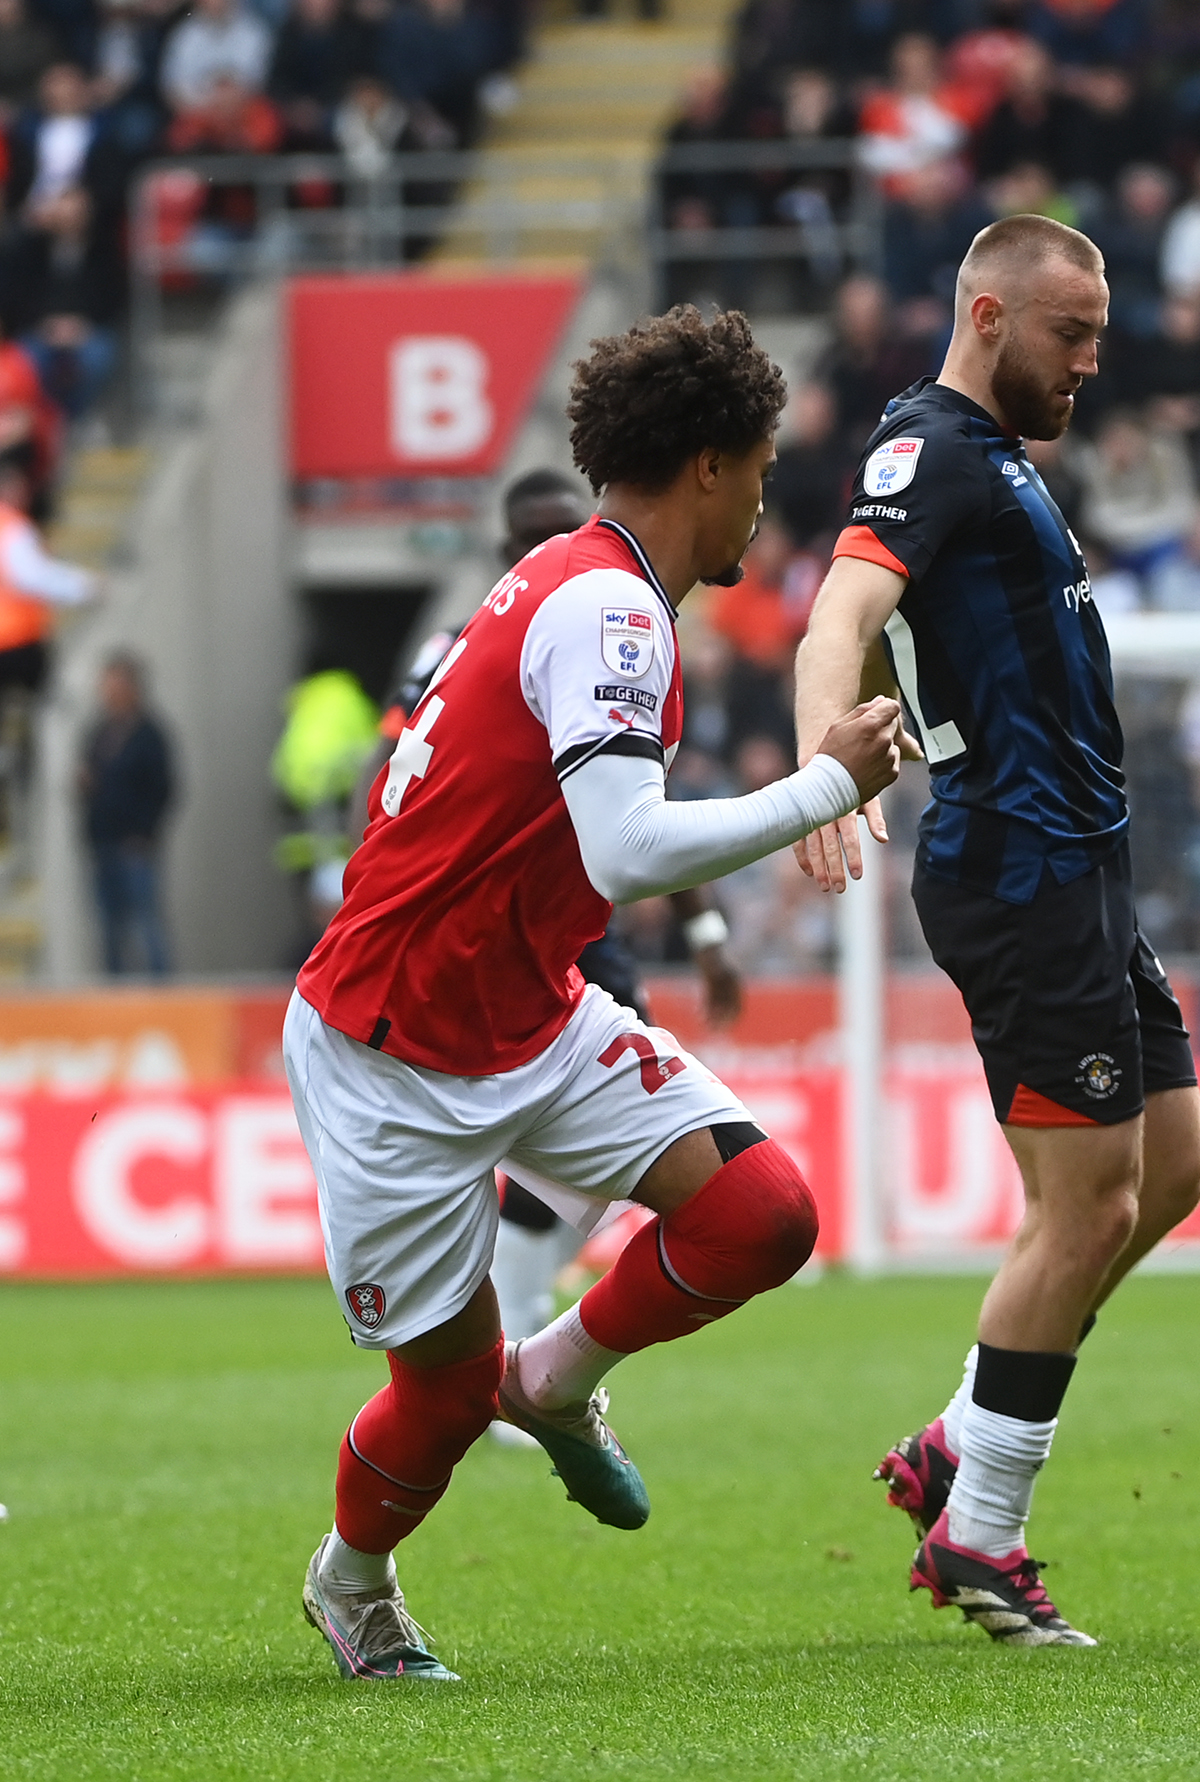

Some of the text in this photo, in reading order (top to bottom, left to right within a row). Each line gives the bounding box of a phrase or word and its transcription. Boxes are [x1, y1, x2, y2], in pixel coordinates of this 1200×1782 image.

[387, 332, 496, 462] B
[876, 482, 892, 490] EFL
[605, 612, 649, 628] sky bet
[620, 661, 637, 673] EFL
[597, 686, 655, 709] TOGETHER
